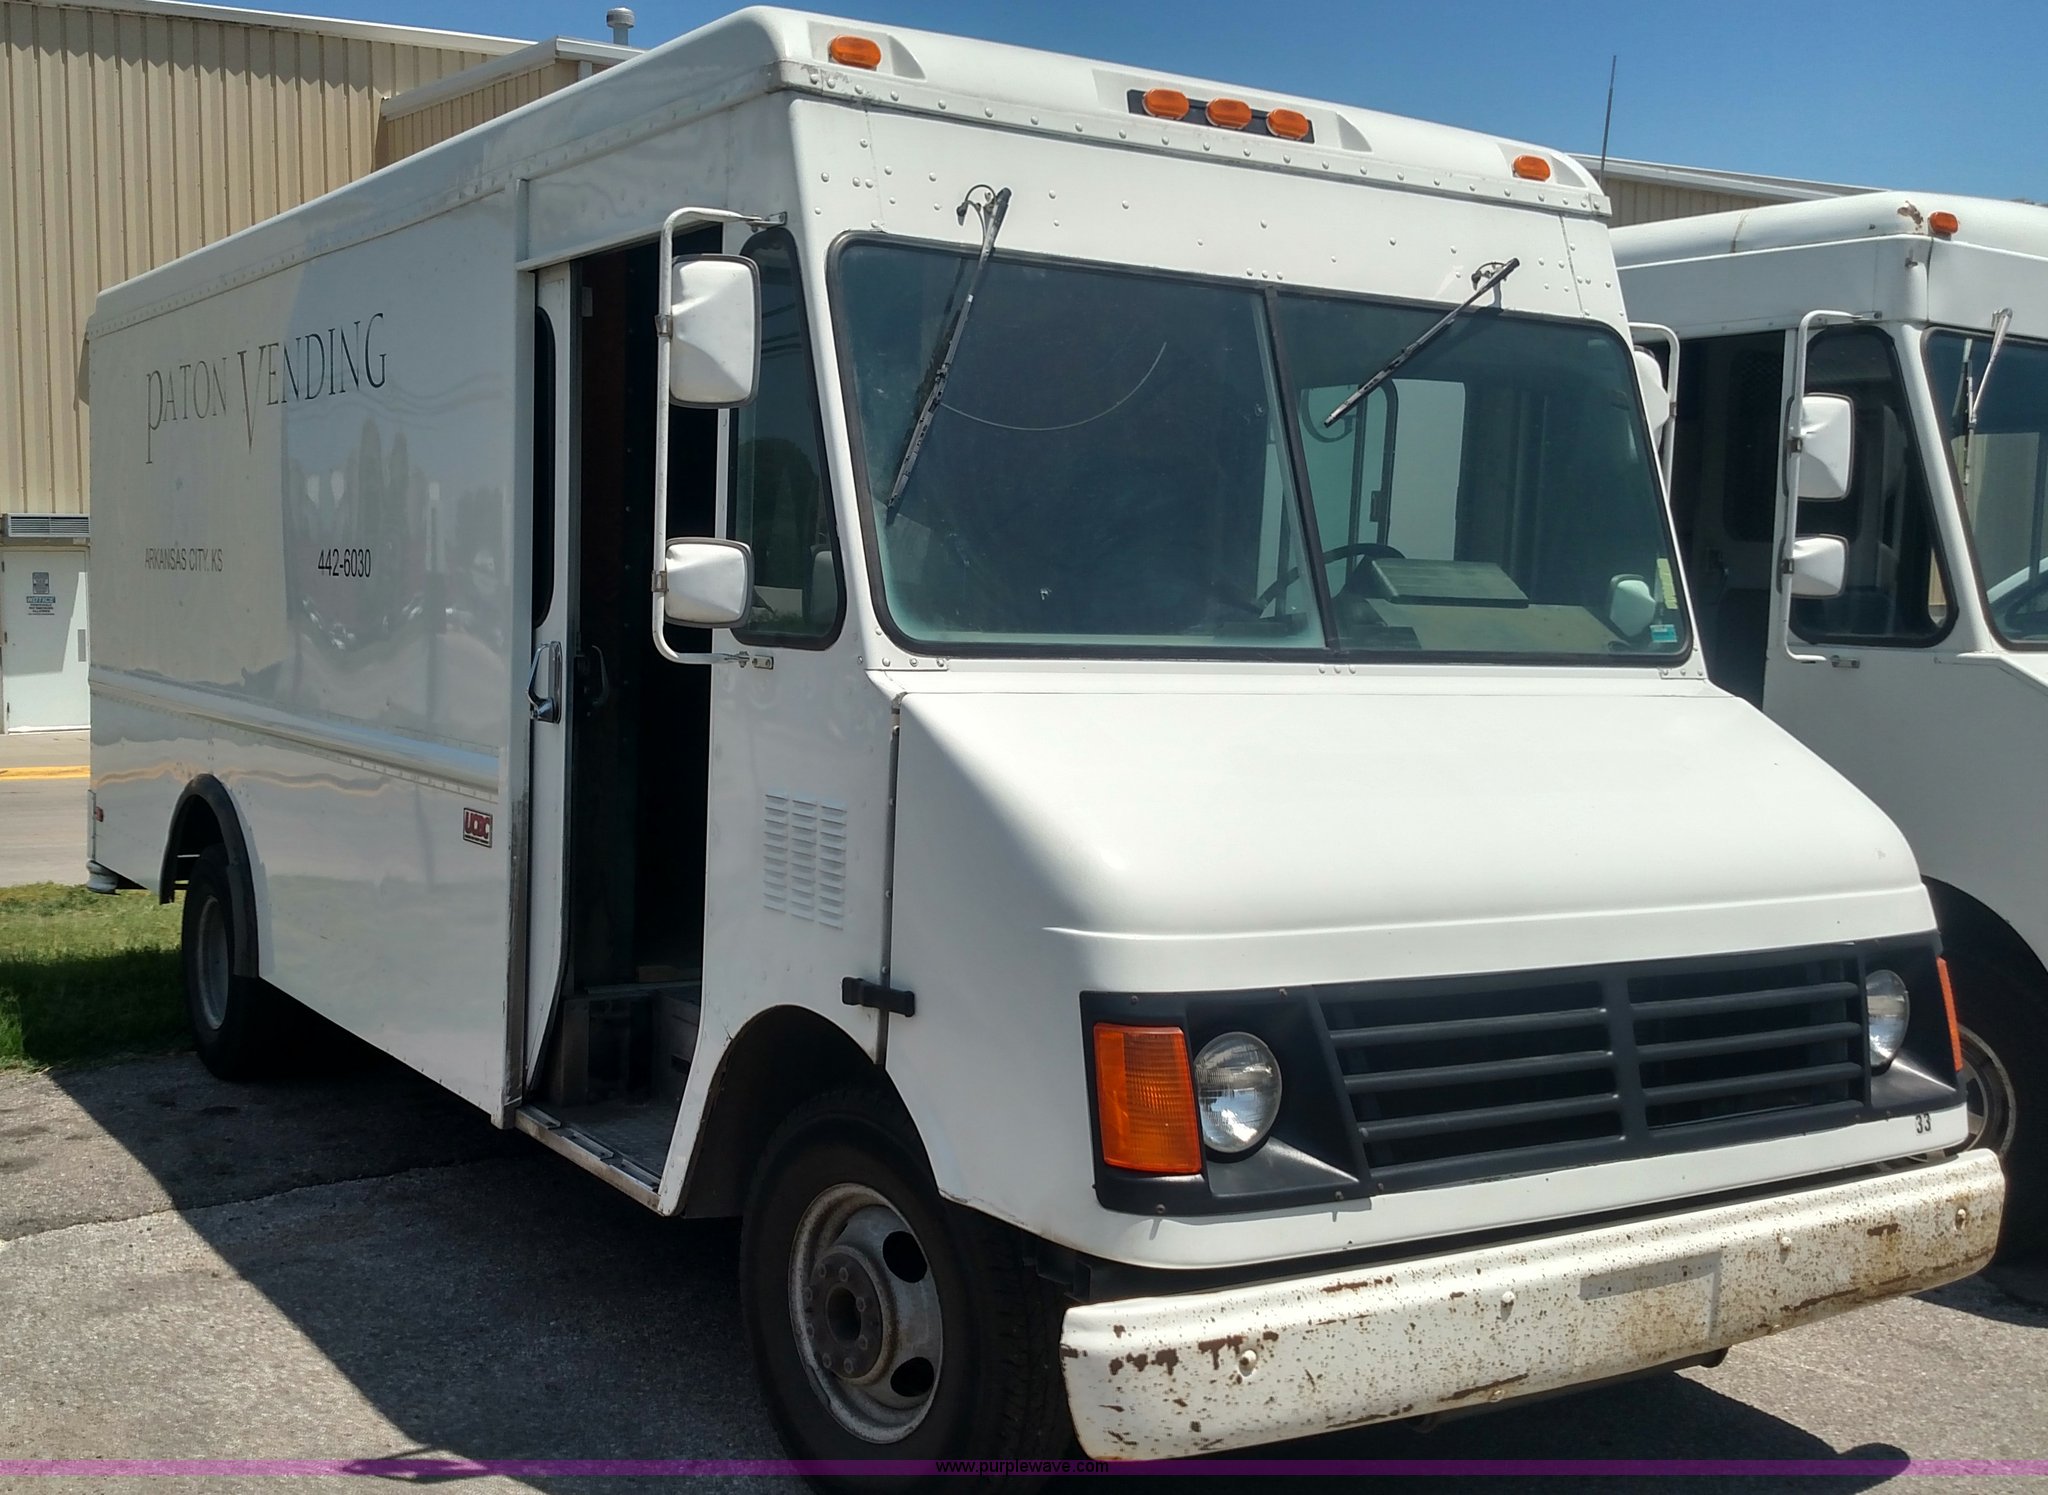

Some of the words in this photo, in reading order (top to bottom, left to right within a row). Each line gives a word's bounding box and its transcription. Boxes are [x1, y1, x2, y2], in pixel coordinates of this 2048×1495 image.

[145, 357, 227, 465] PATON
[237, 312, 387, 455] VENDING
[145, 547, 187, 571] ARKANSAS
[211, 548, 223, 572] KS
[317, 548, 372, 578] 442-6030
[1915, 1112, 1932, 1134] 33
